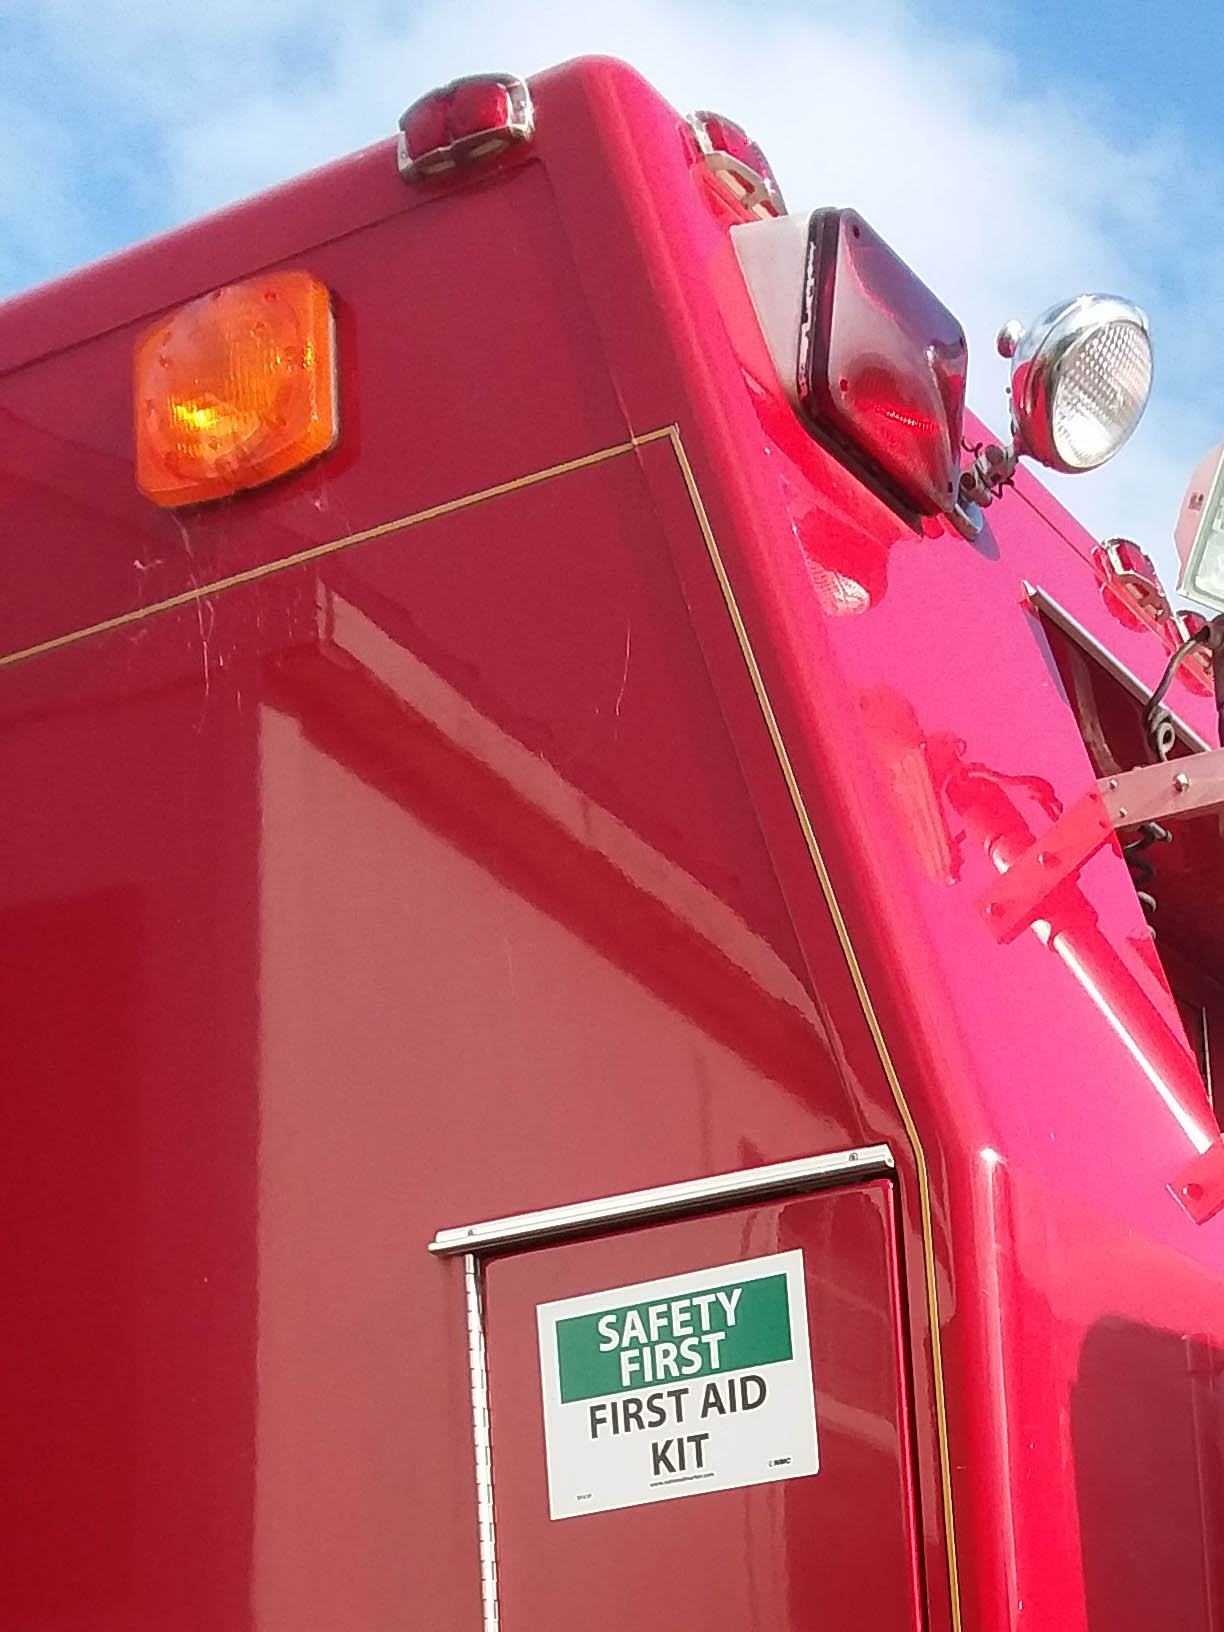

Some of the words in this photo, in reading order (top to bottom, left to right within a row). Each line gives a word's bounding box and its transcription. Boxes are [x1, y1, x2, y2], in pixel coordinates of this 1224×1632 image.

[598, 1288, 742, 1352] SAFETY
[620, 1331, 726, 1387] FIRST
[589, 1387, 690, 1439] FIRST
[700, 1374, 767, 1419] AID
[651, 1432, 709, 1476] KIT
